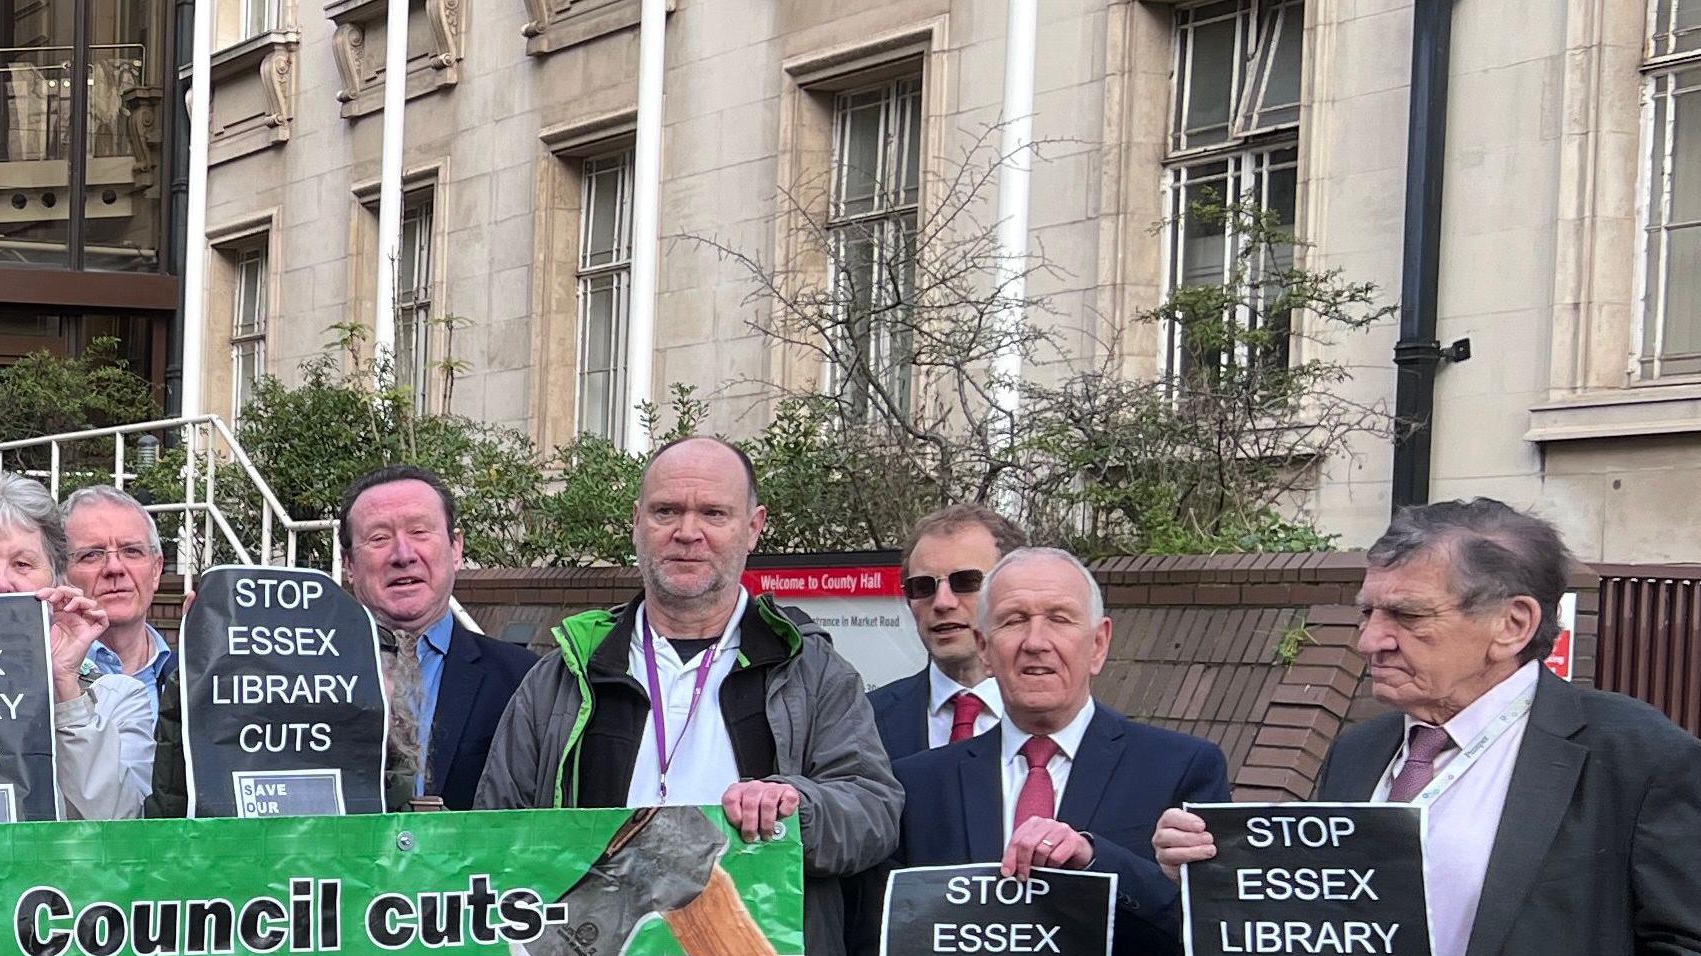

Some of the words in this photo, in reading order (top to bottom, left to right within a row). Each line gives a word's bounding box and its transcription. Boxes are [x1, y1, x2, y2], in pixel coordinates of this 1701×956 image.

[236, 578, 323, 609] STOP
[760, 574, 805, 590] Welcome
[808, 576, 819, 589] to
[821, 573, 857, 592] County
[860, 572, 881, 589] Hall
[813, 616, 840, 627] trance
[842, 615, 849, 627] in
[851, 616, 879, 627] Market
[880, 615, 900, 627] Road
[228, 626, 339, 656] ESSEX
[212, 674, 358, 705] LIBRARY
[239, 723, 332, 752] CUTS
[244, 783, 287, 796] SAVE
[247, 801, 279, 813] OUR
[1246, 816, 1355, 847] STOP
[945, 875, 1050, 905] STOP
[1236, 868, 1379, 900] ESSEX
[364, 873, 569, 951] cuts-
[932, 923, 1061, 953] ESSEX
[1220, 921, 1399, 953] LIBRARY
